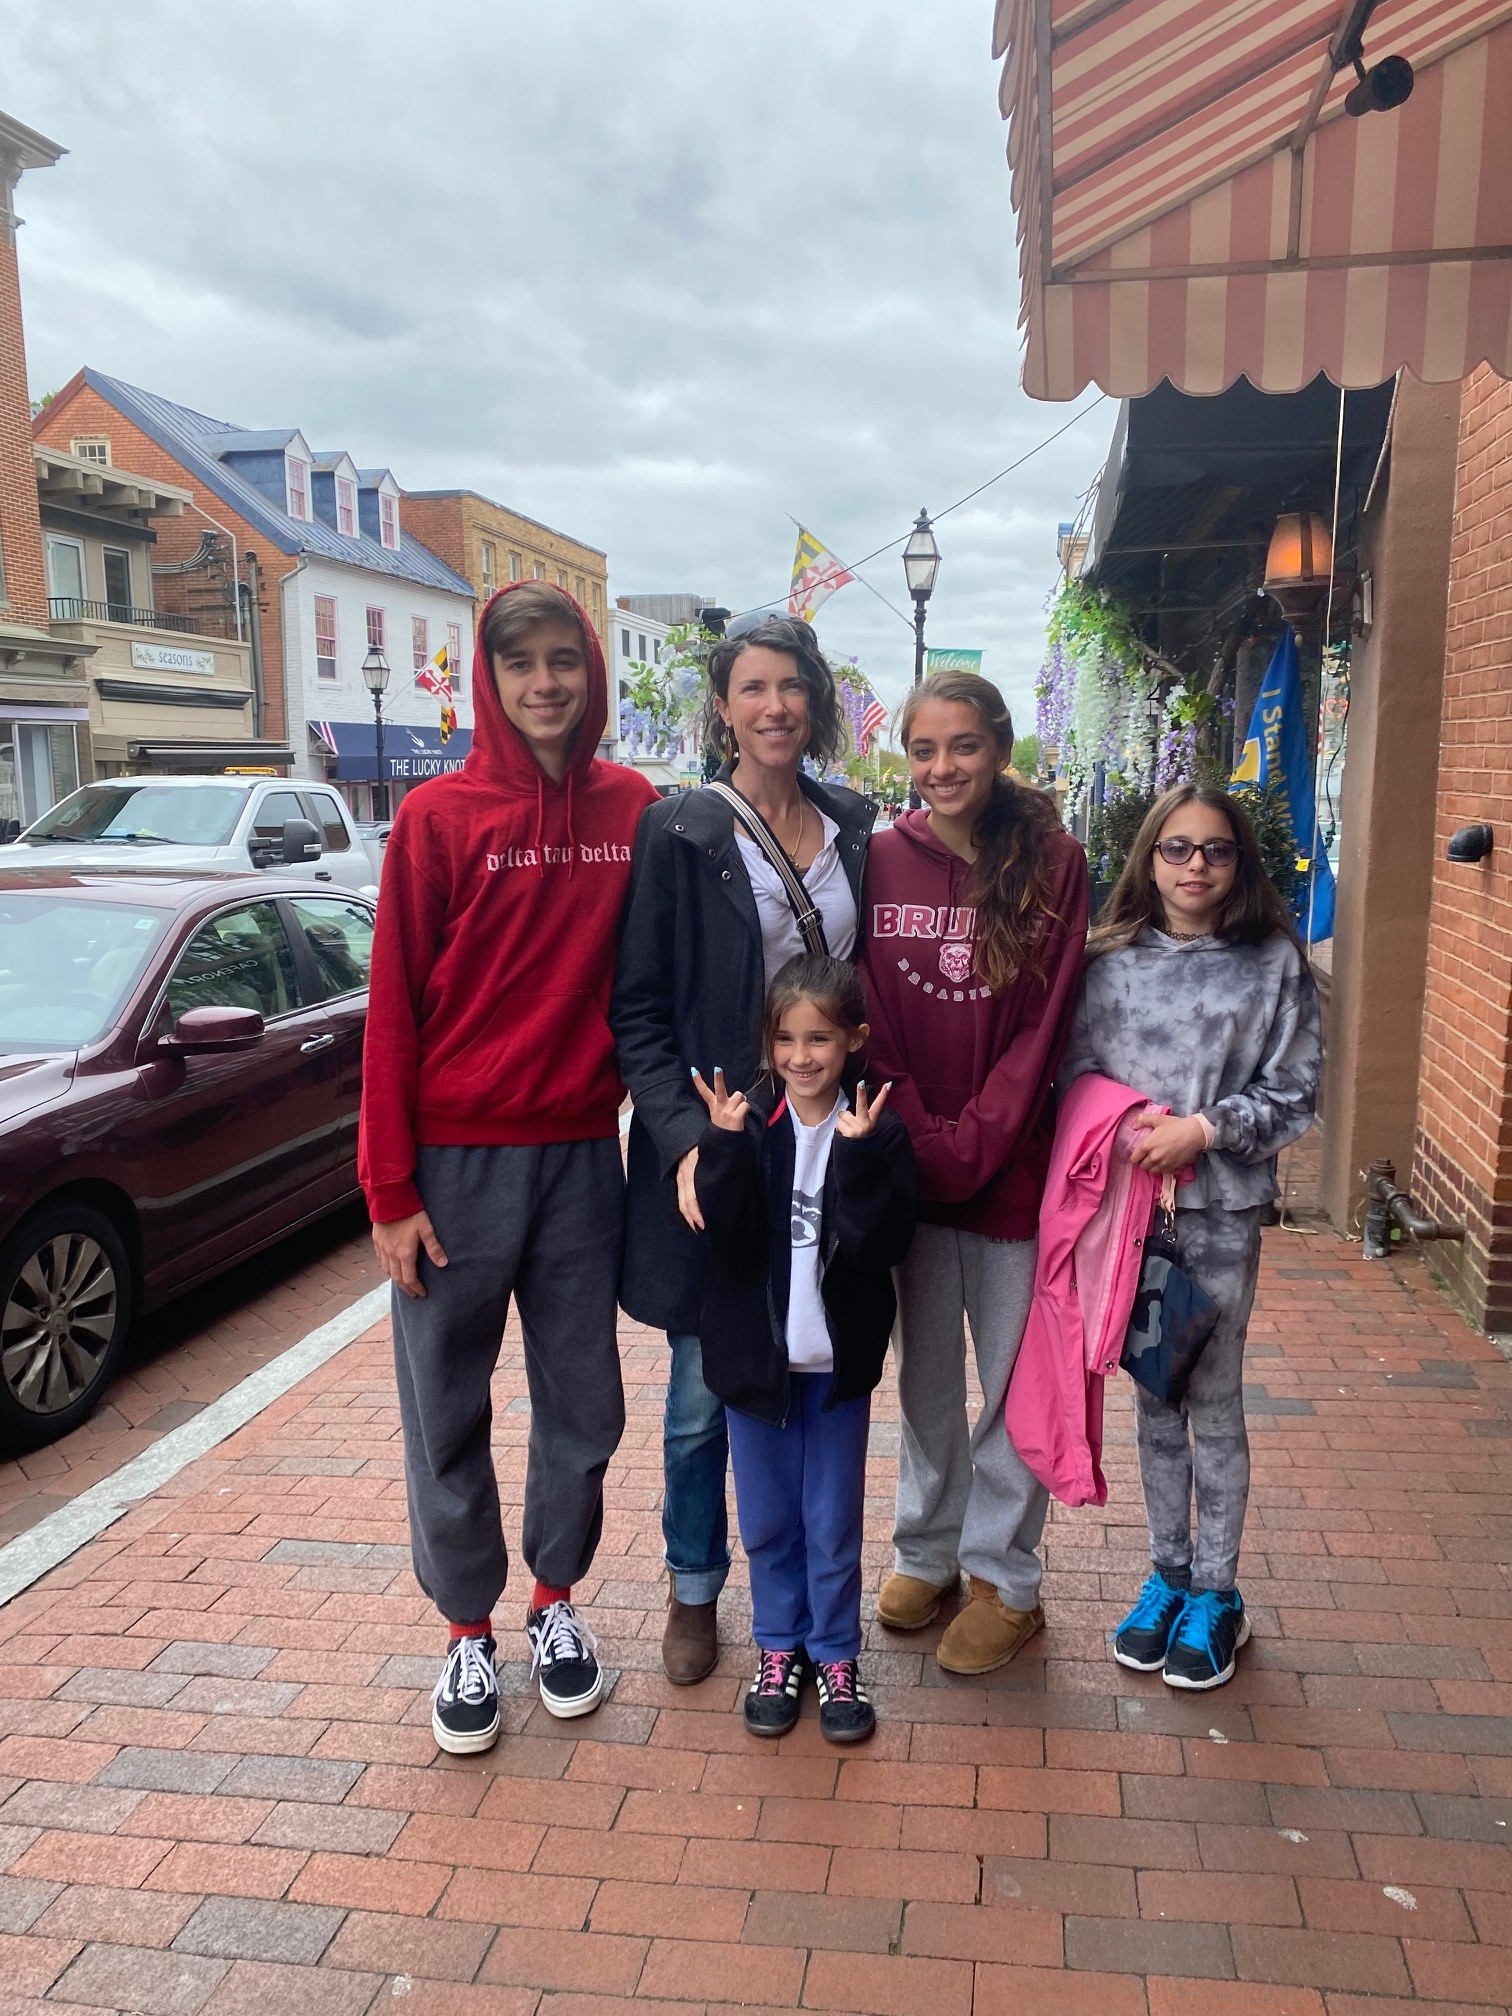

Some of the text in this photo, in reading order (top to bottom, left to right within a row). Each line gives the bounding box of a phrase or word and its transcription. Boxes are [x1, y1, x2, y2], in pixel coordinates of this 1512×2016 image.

[158, 652, 193, 667] seasons
[929, 652, 978, 669] Welcome
[1261, 688, 1281, 699] I
[1262, 705, 1288, 789] Stand
[389, 759, 466, 776] THE LUCKY KNOT
[486, 841, 632, 872] delta tau delta
